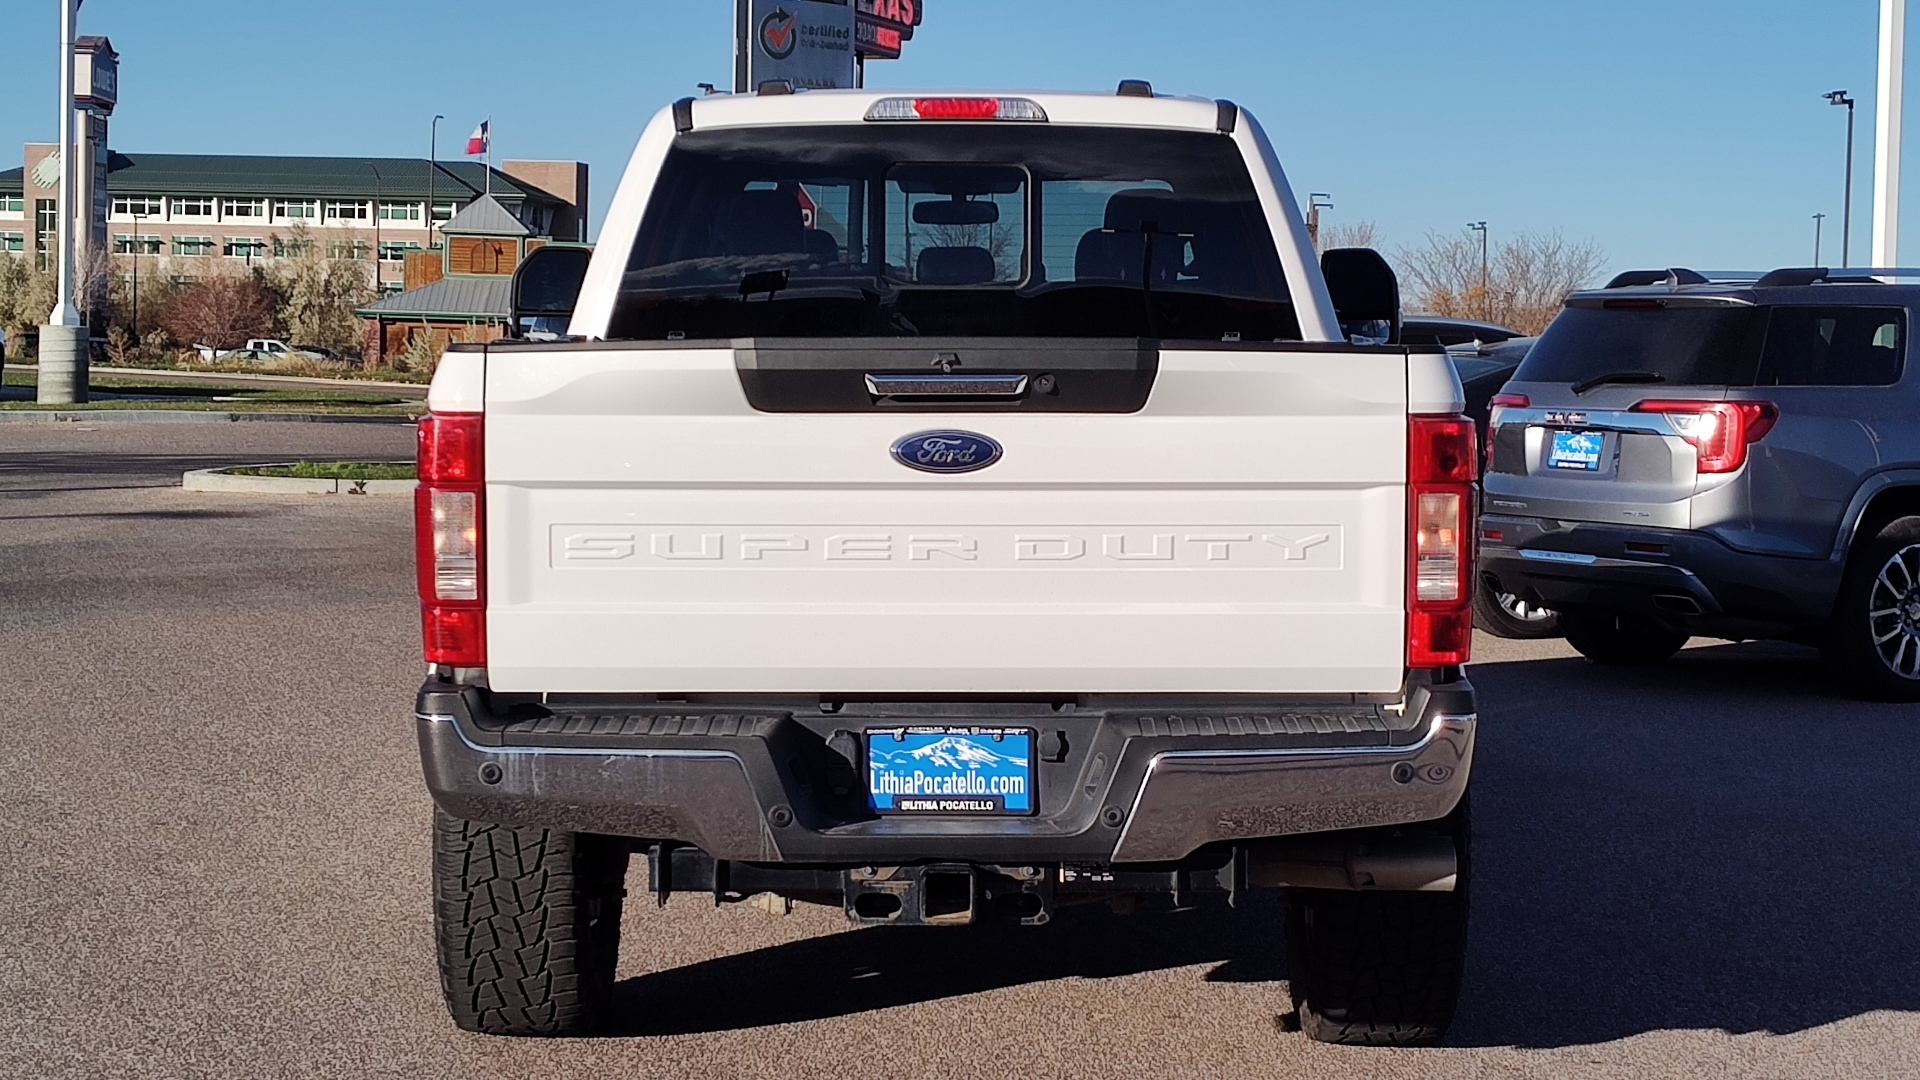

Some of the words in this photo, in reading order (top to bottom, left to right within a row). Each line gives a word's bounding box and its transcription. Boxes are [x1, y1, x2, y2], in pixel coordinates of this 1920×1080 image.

[801, 24, 850, 39] certified
[917, 438, 977, 463] Ford
[564, 533, 978, 561] SUPER
[1014, 533, 1330, 561] DUTY
[870, 769, 1025, 795] LithiaPocatello.com
[910, 800, 939, 811] LITHIA
[939, 800, 994, 811] POCATELLO
